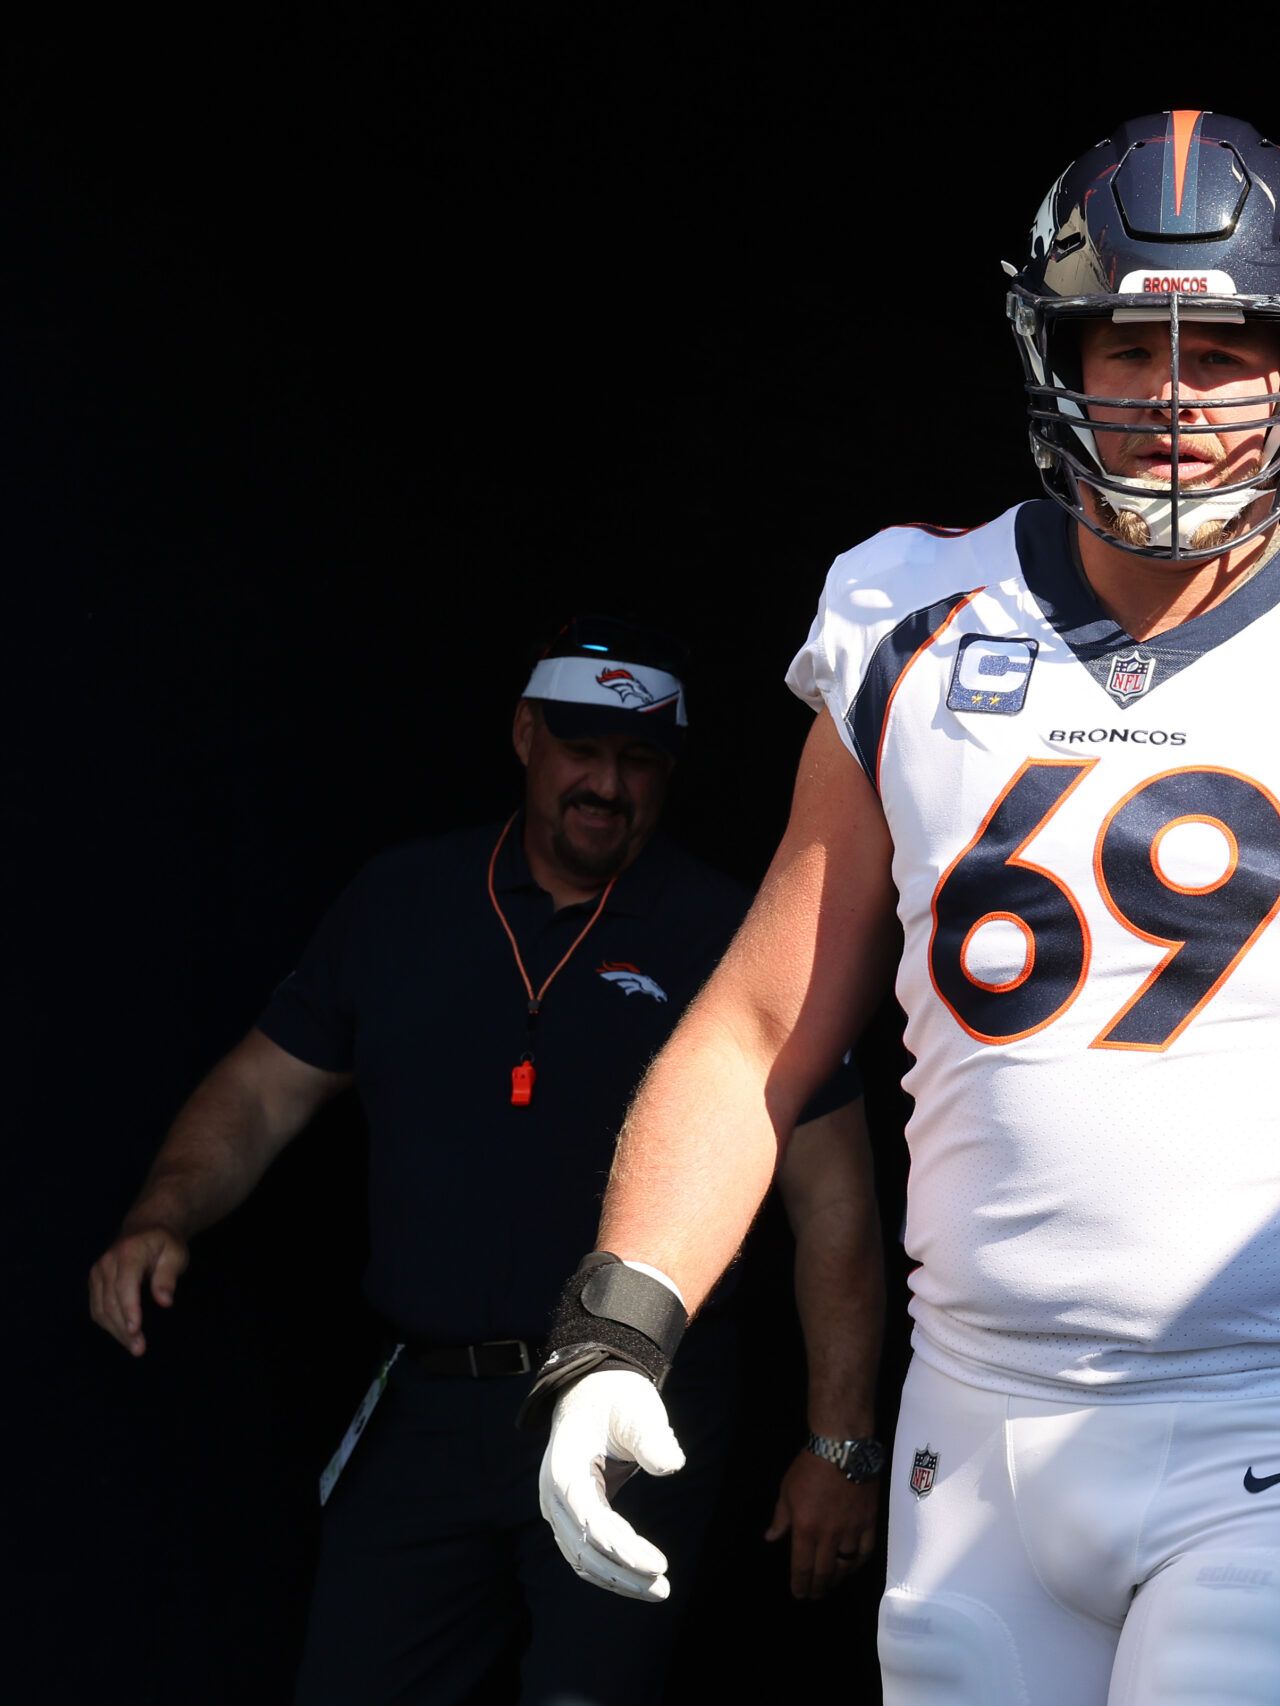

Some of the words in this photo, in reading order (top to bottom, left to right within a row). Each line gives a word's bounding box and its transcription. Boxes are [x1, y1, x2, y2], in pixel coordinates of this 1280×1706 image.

[1143, 277, 1208, 293] BRONCOS
[958, 640, 1031, 693] C
[1112, 672, 1142, 692] NFL
[1049, 728, 1187, 746] BRONCOS
[912, 1467, 931, 1490] NFL
